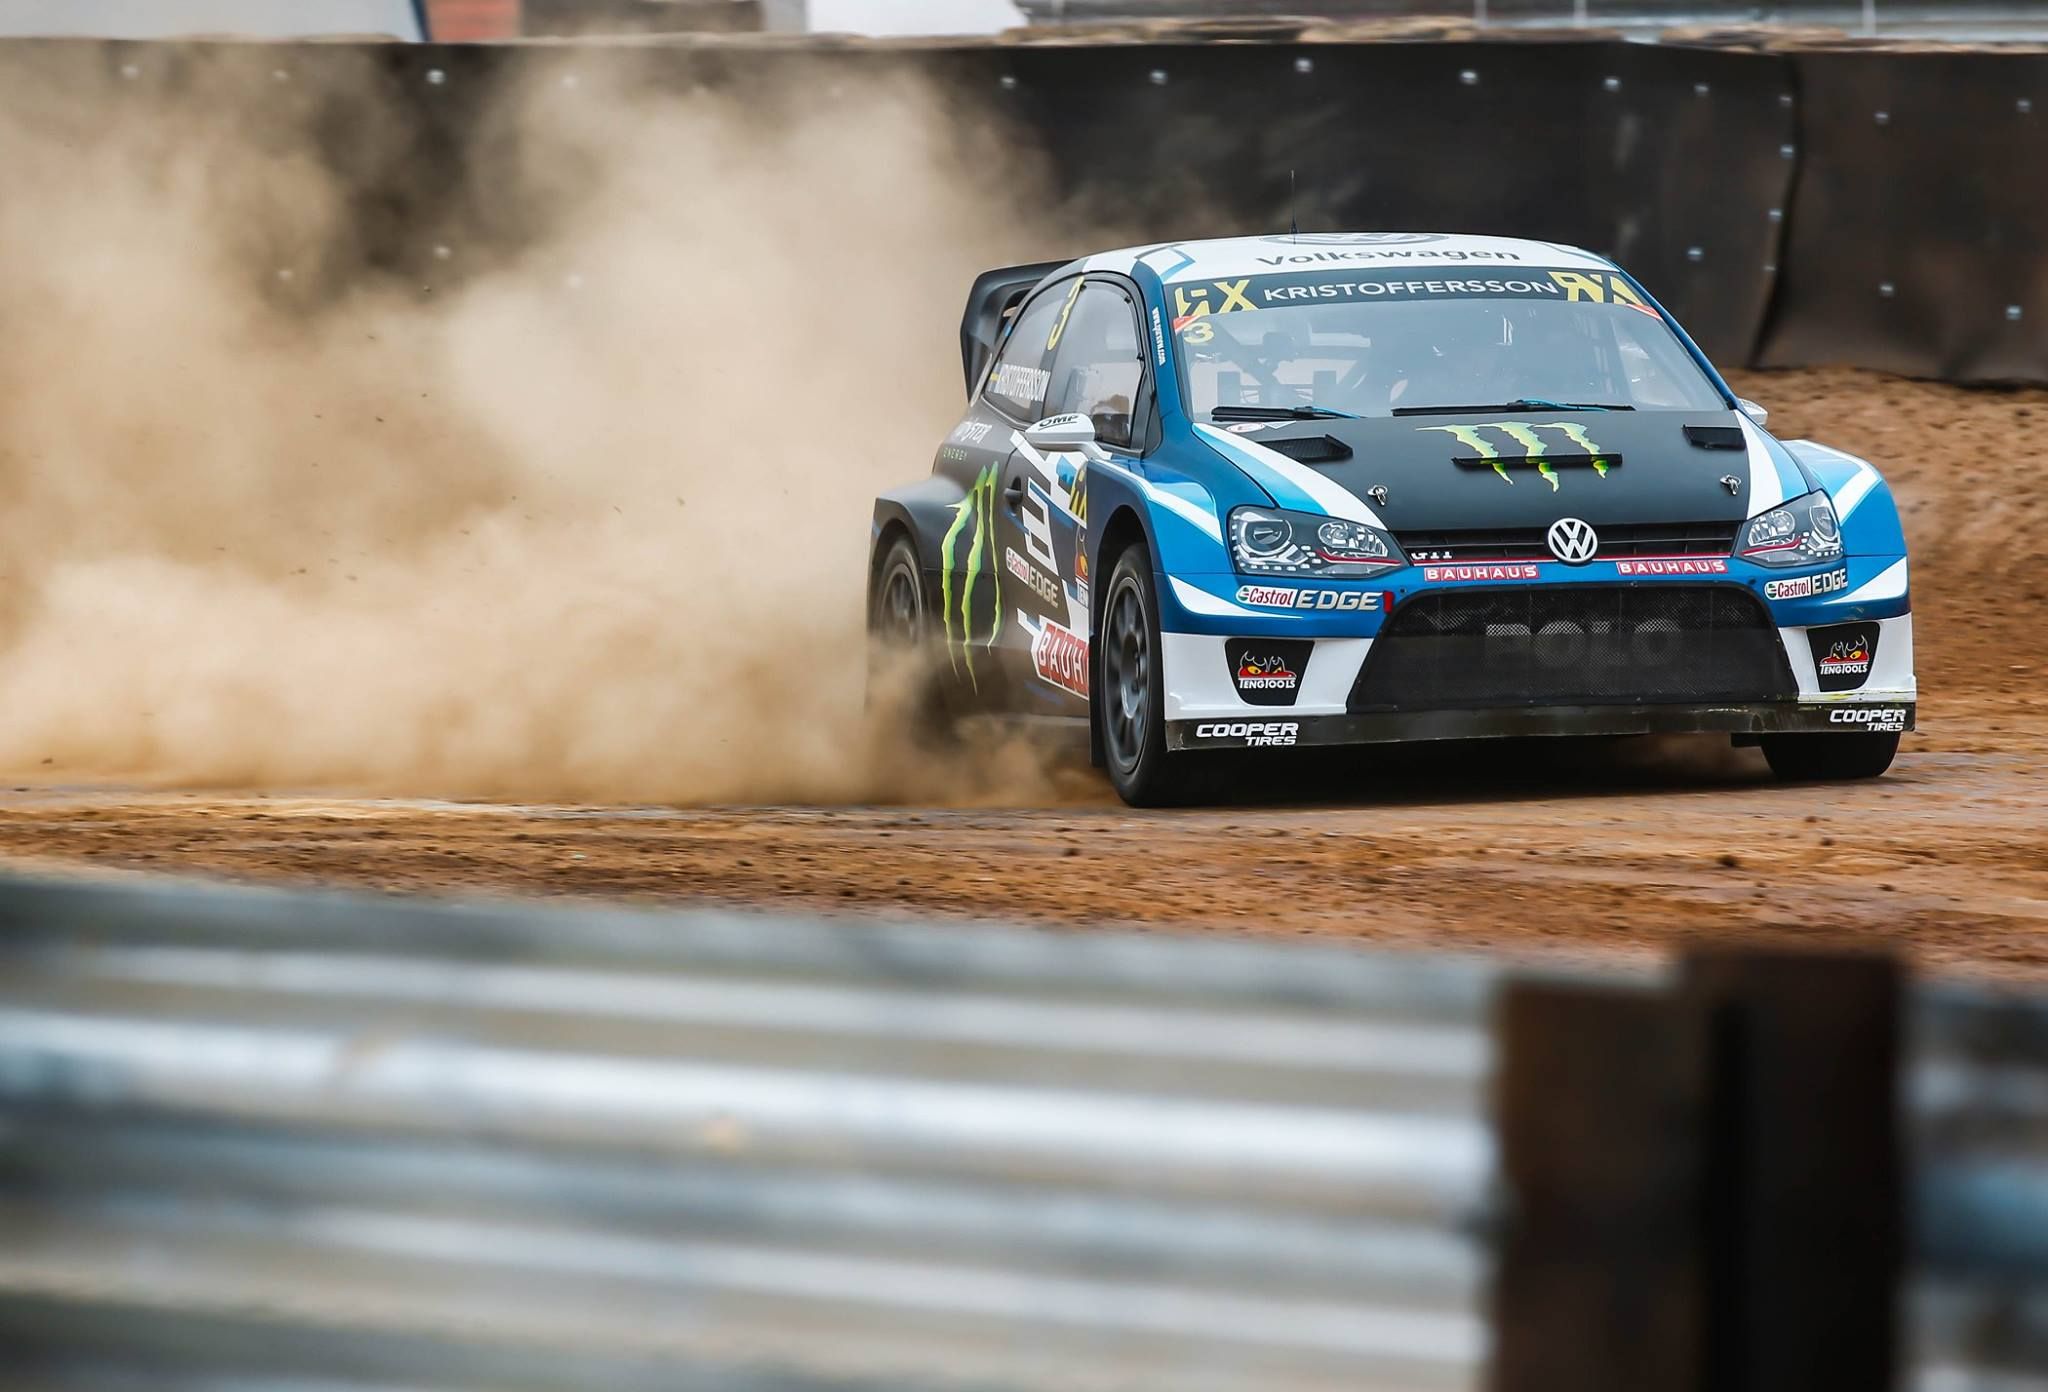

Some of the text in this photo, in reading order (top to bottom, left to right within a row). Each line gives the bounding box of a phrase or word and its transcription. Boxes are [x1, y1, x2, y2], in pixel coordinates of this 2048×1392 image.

[1256, 249, 1520, 266] Volkswagen
[1263, 280, 1560, 301] KRISTOFFERSSON
[1183, 321, 1215, 345] 3
[1039, 414, 1079, 428] OMP
[1427, 565, 1537, 580] BAUHAUS
[1619, 560, 1727, 575] BAUHAUS
[1029, 565, 1059, 609] EDGE
[1777, 567, 1849, 598] Castrol EDGE
[1249, 587, 1384, 611] Castrol EDGE
[1038, 631, 1089, 686] BAUH
[1830, 708, 1906, 723] COOPER
[1196, 722, 1299, 738] COOPER
[1866, 722, 1905, 732] TIRES
[1244, 736, 1297, 747] TIRES
